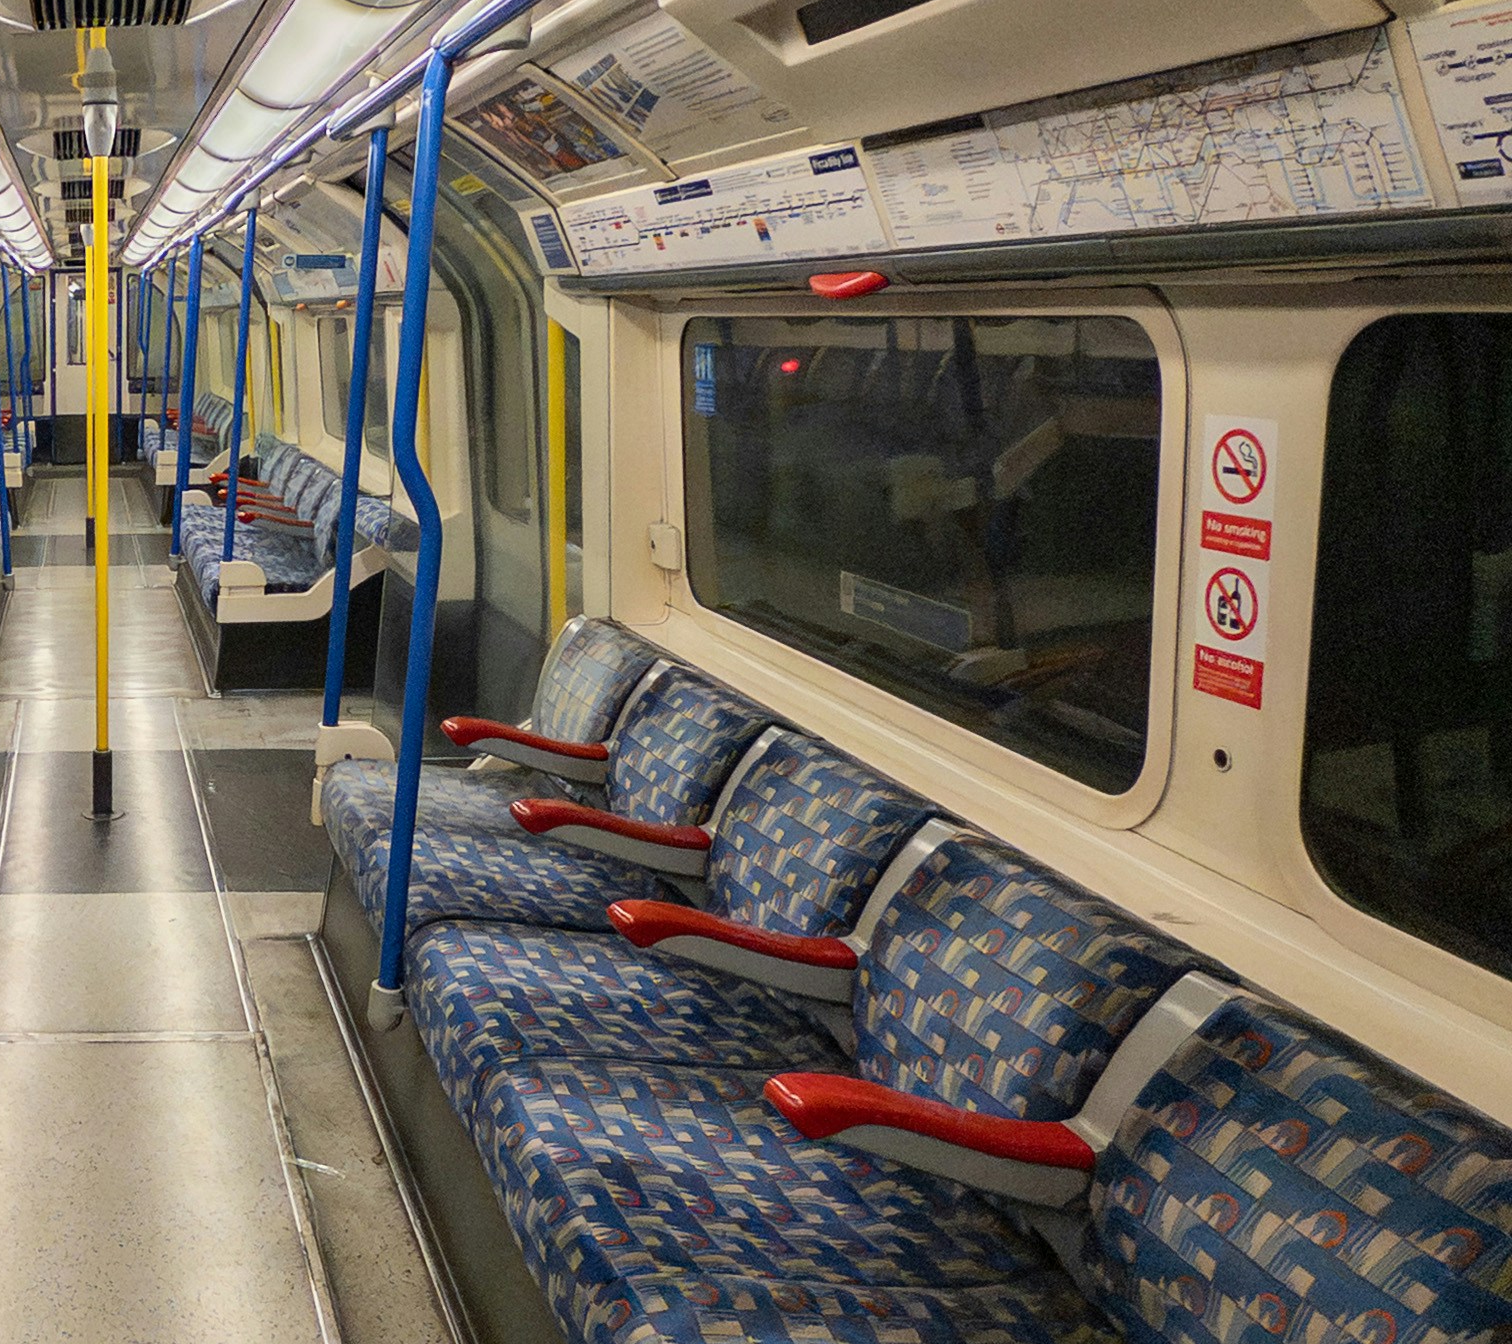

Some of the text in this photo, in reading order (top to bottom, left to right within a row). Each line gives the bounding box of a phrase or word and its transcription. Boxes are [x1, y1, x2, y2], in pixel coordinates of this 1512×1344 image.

[1206, 518, 1222, 533] No
[1224, 524, 1267, 544] smoking
[1199, 649, 1254, 675] No alcohol
